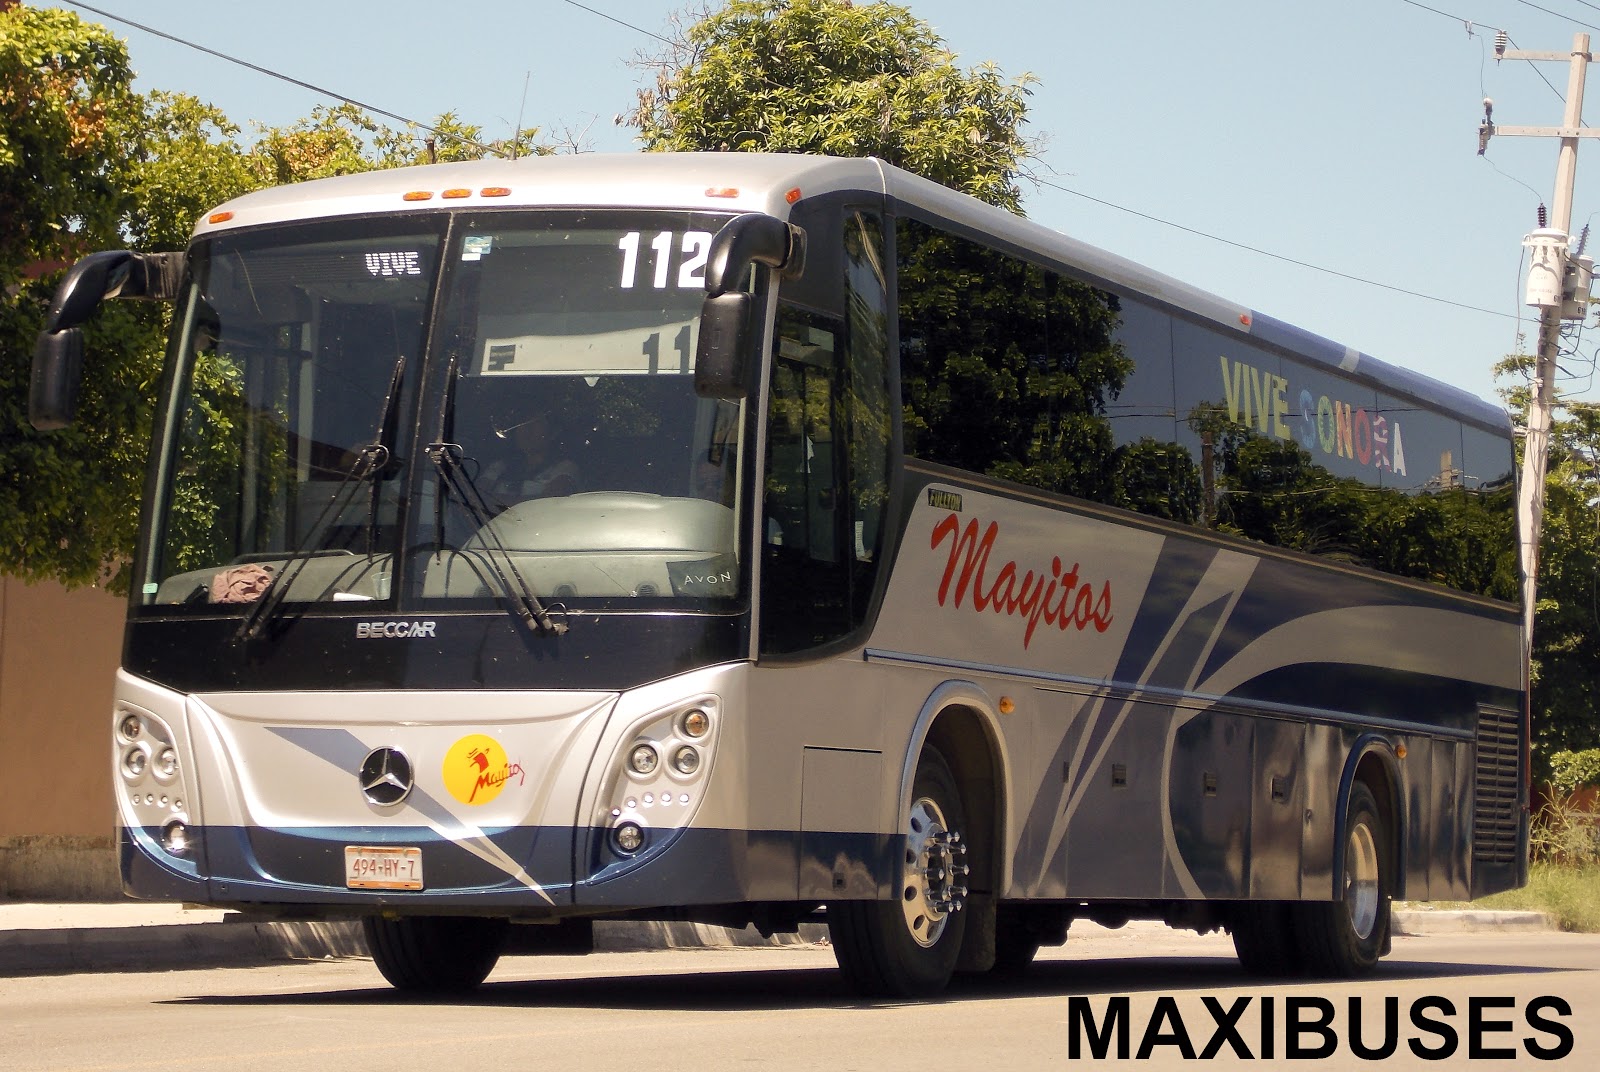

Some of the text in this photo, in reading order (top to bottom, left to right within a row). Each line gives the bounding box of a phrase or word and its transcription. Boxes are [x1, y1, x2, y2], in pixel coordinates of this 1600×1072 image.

[365, 251, 421, 276] VIVE
[618, 231, 713, 288] 112
[1220, 355, 1407, 477] VIVE SONORA
[684, 571, 731, 586] AVON
[930, 512, 1114, 651] Mayitos
[356, 621, 437, 639] BECCAR
[353, 858, 415, 878] 494-HY-7
